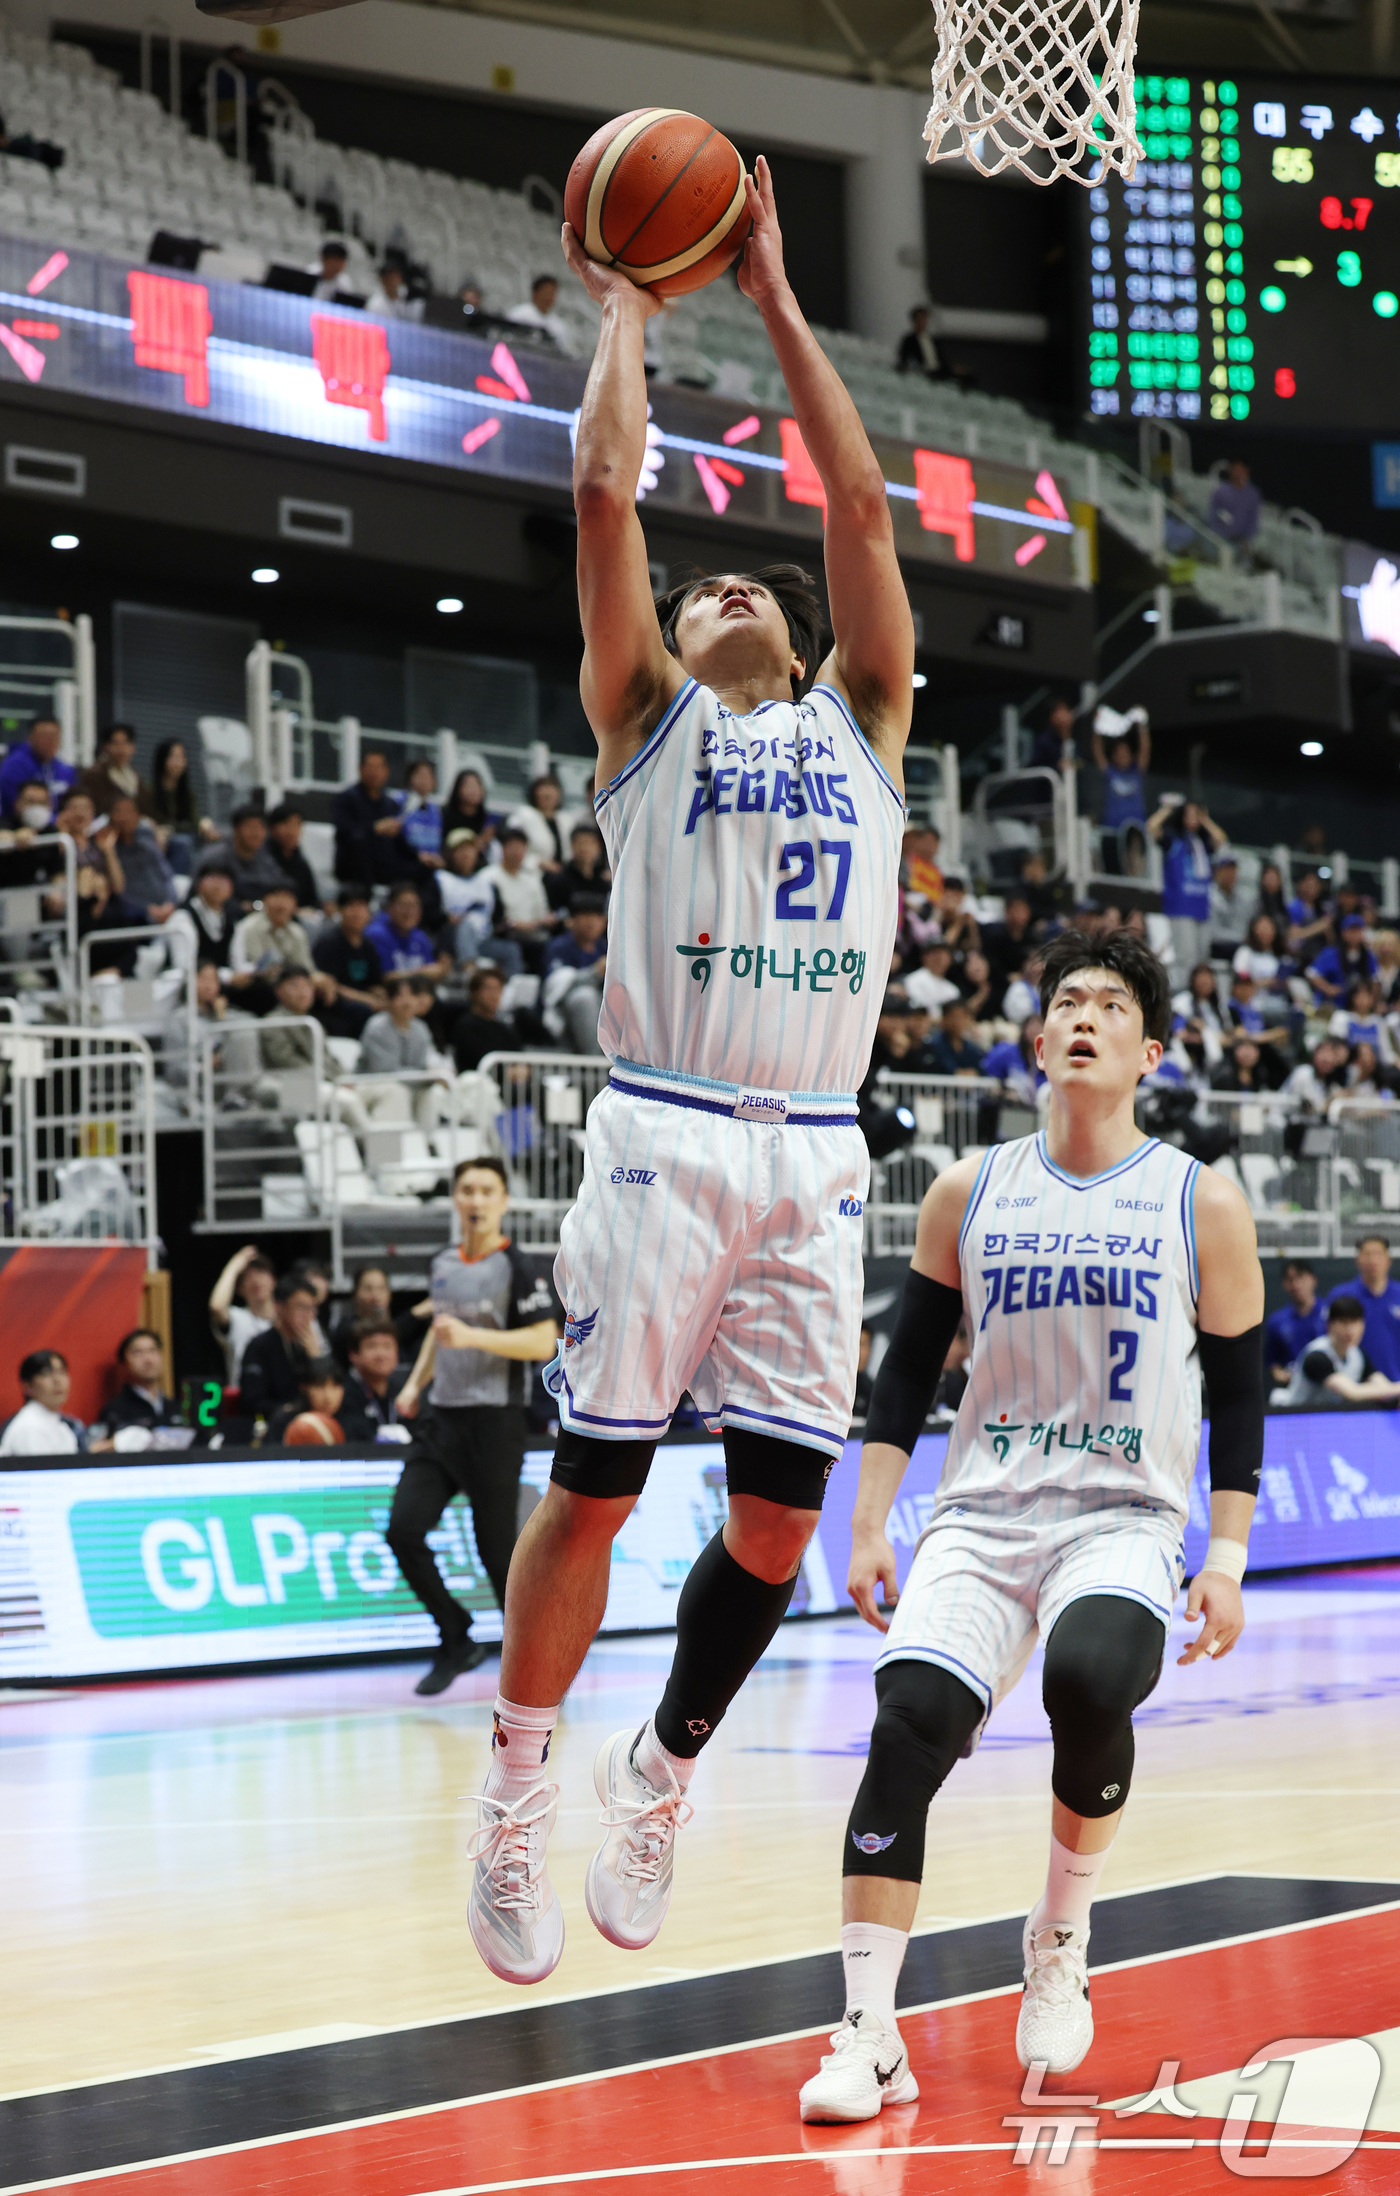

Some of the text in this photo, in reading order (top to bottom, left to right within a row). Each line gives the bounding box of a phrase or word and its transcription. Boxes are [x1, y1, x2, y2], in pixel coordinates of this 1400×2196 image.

[1337, 251, 1362, 286] 3
[684, 767, 858, 836] PEGASUS
[775, 839, 852, 922] 27
[730, 944, 867, 995] 하나은행
[741, 1095, 786, 1114] PEGASUS
[626, 1169, 658, 1186] STIZ
[1115, 1198, 1164, 1212] DAEGU
[983, 1233, 1163, 1259] 한국가스공사
[979, 1265, 1163, 1333] PEGASUS
[1109, 1329, 1139, 1402] 2
[198, 1381, 222, 1427] 2
[1028, 1421, 1143, 1464] 하나은행
